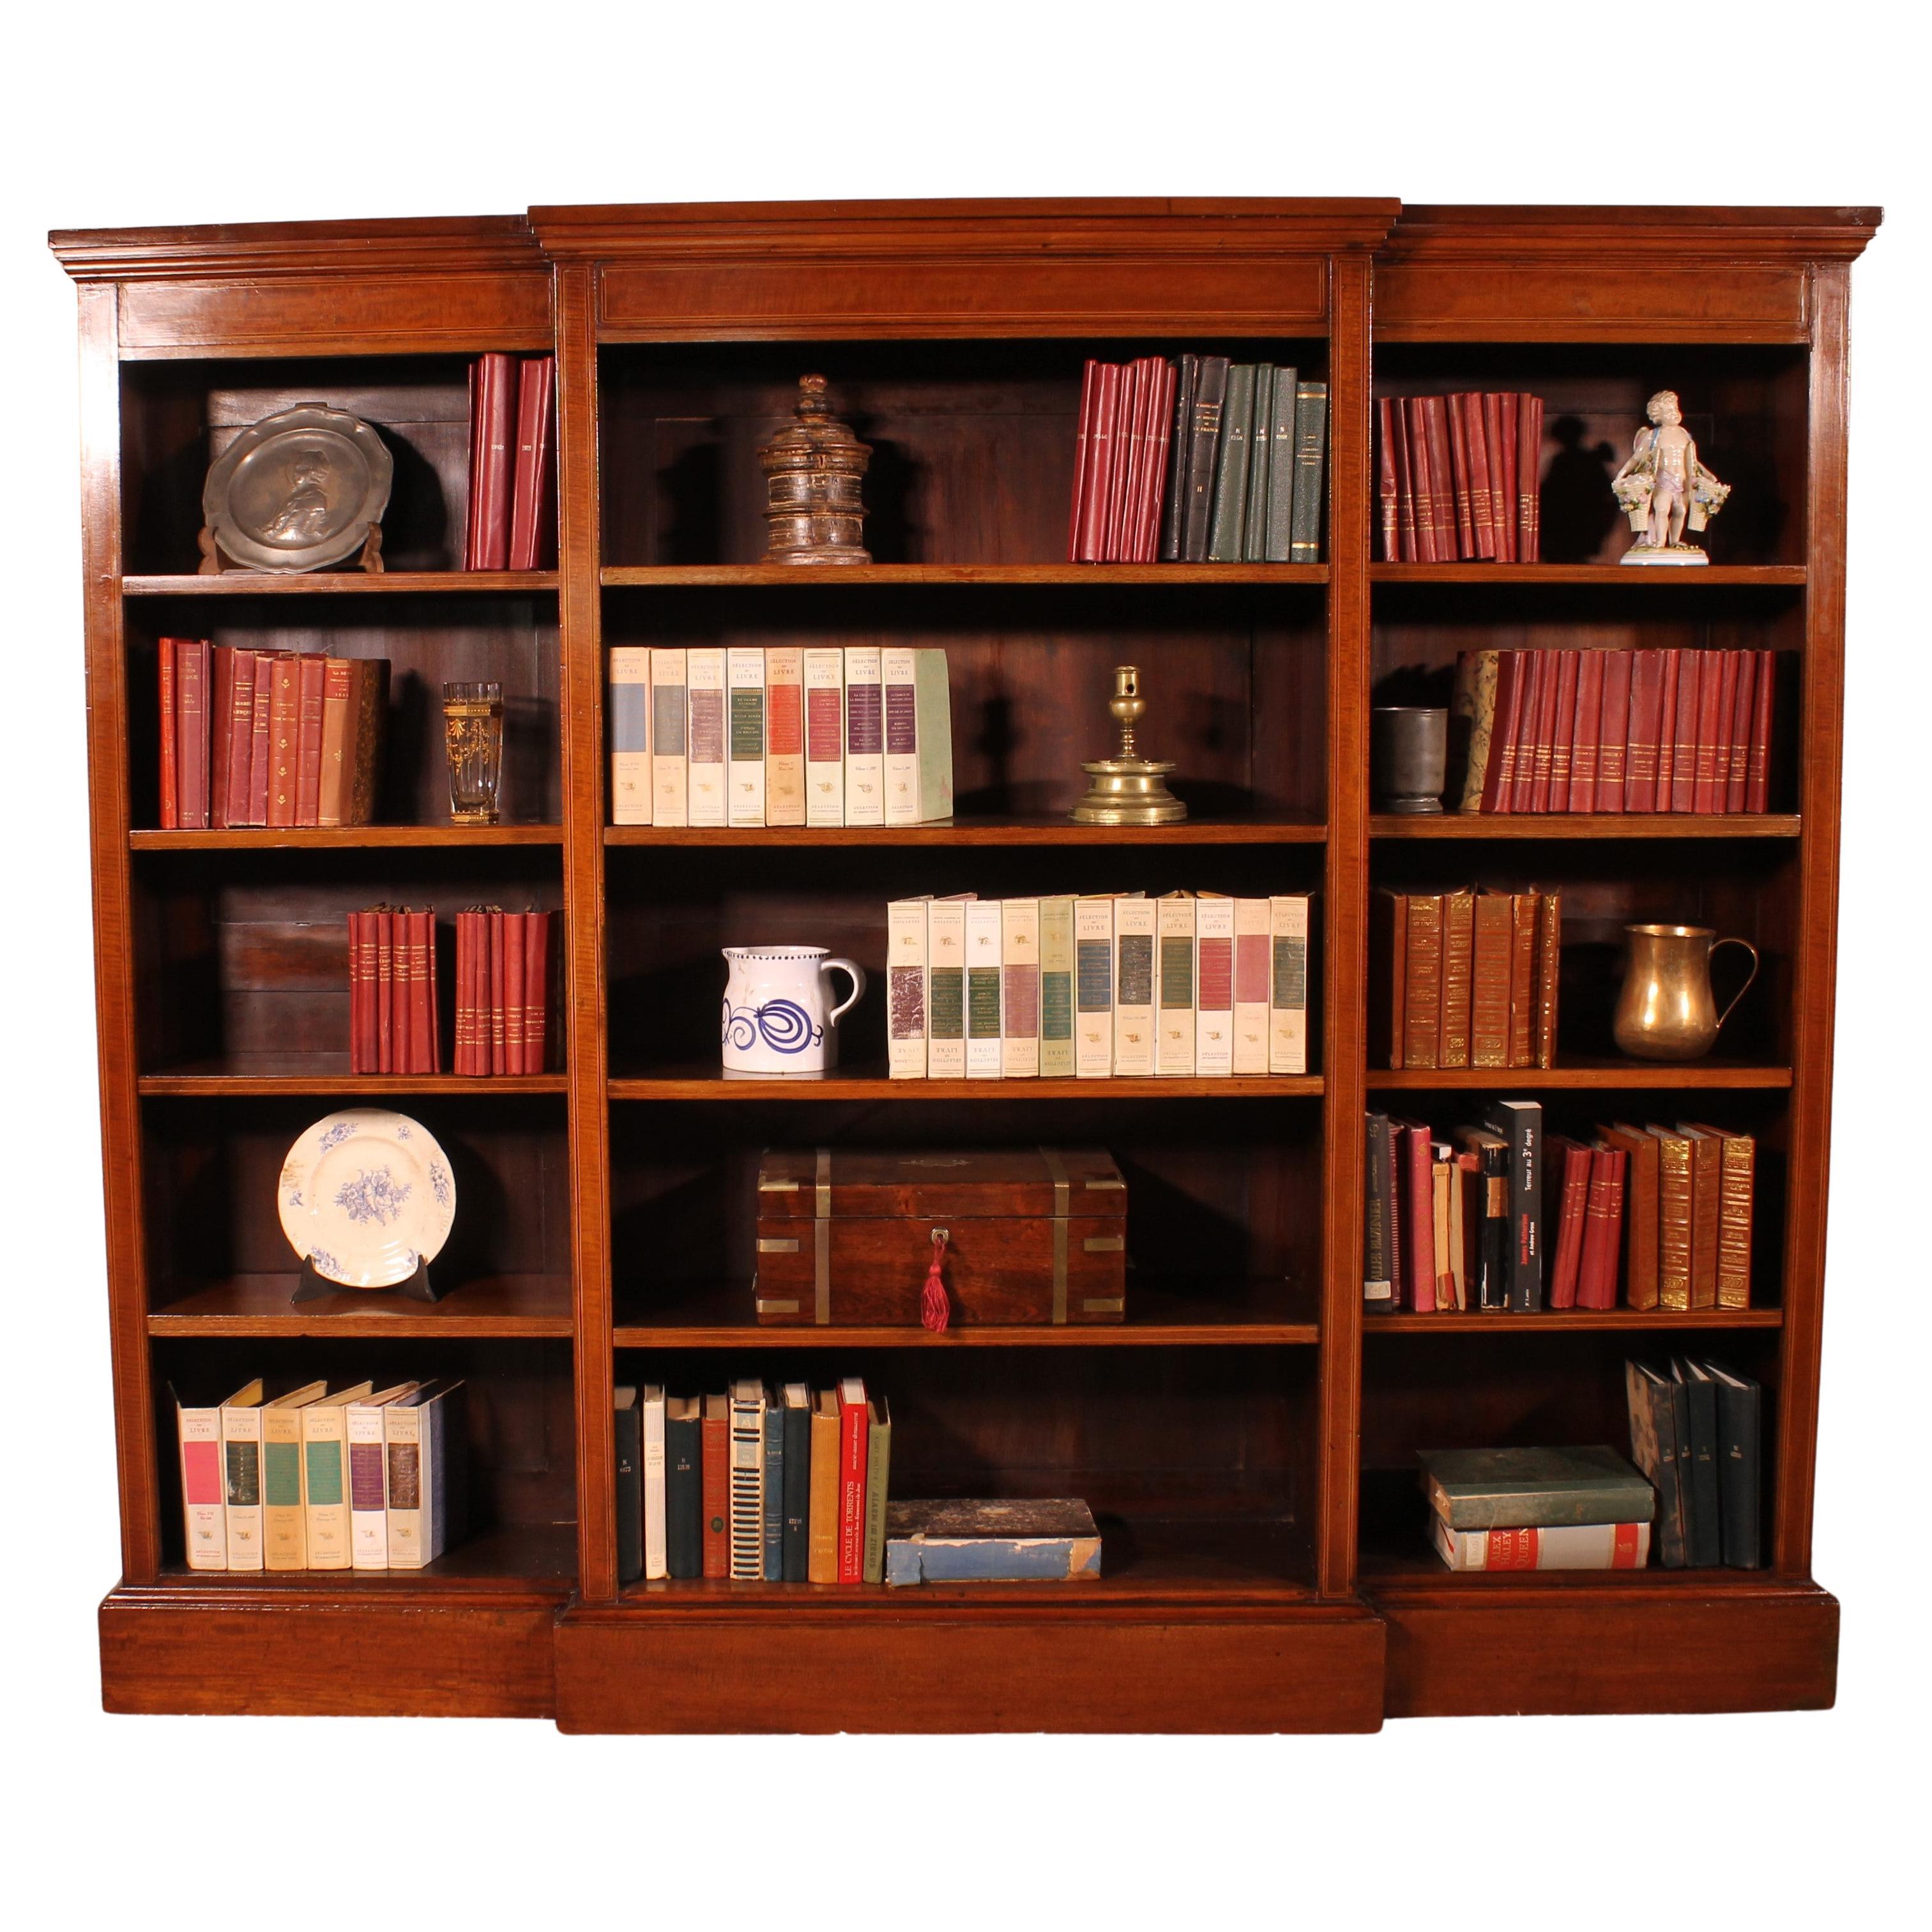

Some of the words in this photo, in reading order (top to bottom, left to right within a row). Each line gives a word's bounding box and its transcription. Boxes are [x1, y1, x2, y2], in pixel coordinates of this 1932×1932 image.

[1524, 1129, 1533, 1147] degré
[1525, 1159, 1532, 1168] au
[1524, 1169, 1532, 1191] Terreur
[846, 1481, 855, 1523] TORRENTS
[846, 1526, 853, 1536] DE
[1491, 1535, 1502, 1562] ALEX
[1501, 1532, 1512, 1564] HALEY
[1515, 1528, 1530, 1568] QUEEN
[845, 1565, 852, 1576] LE
